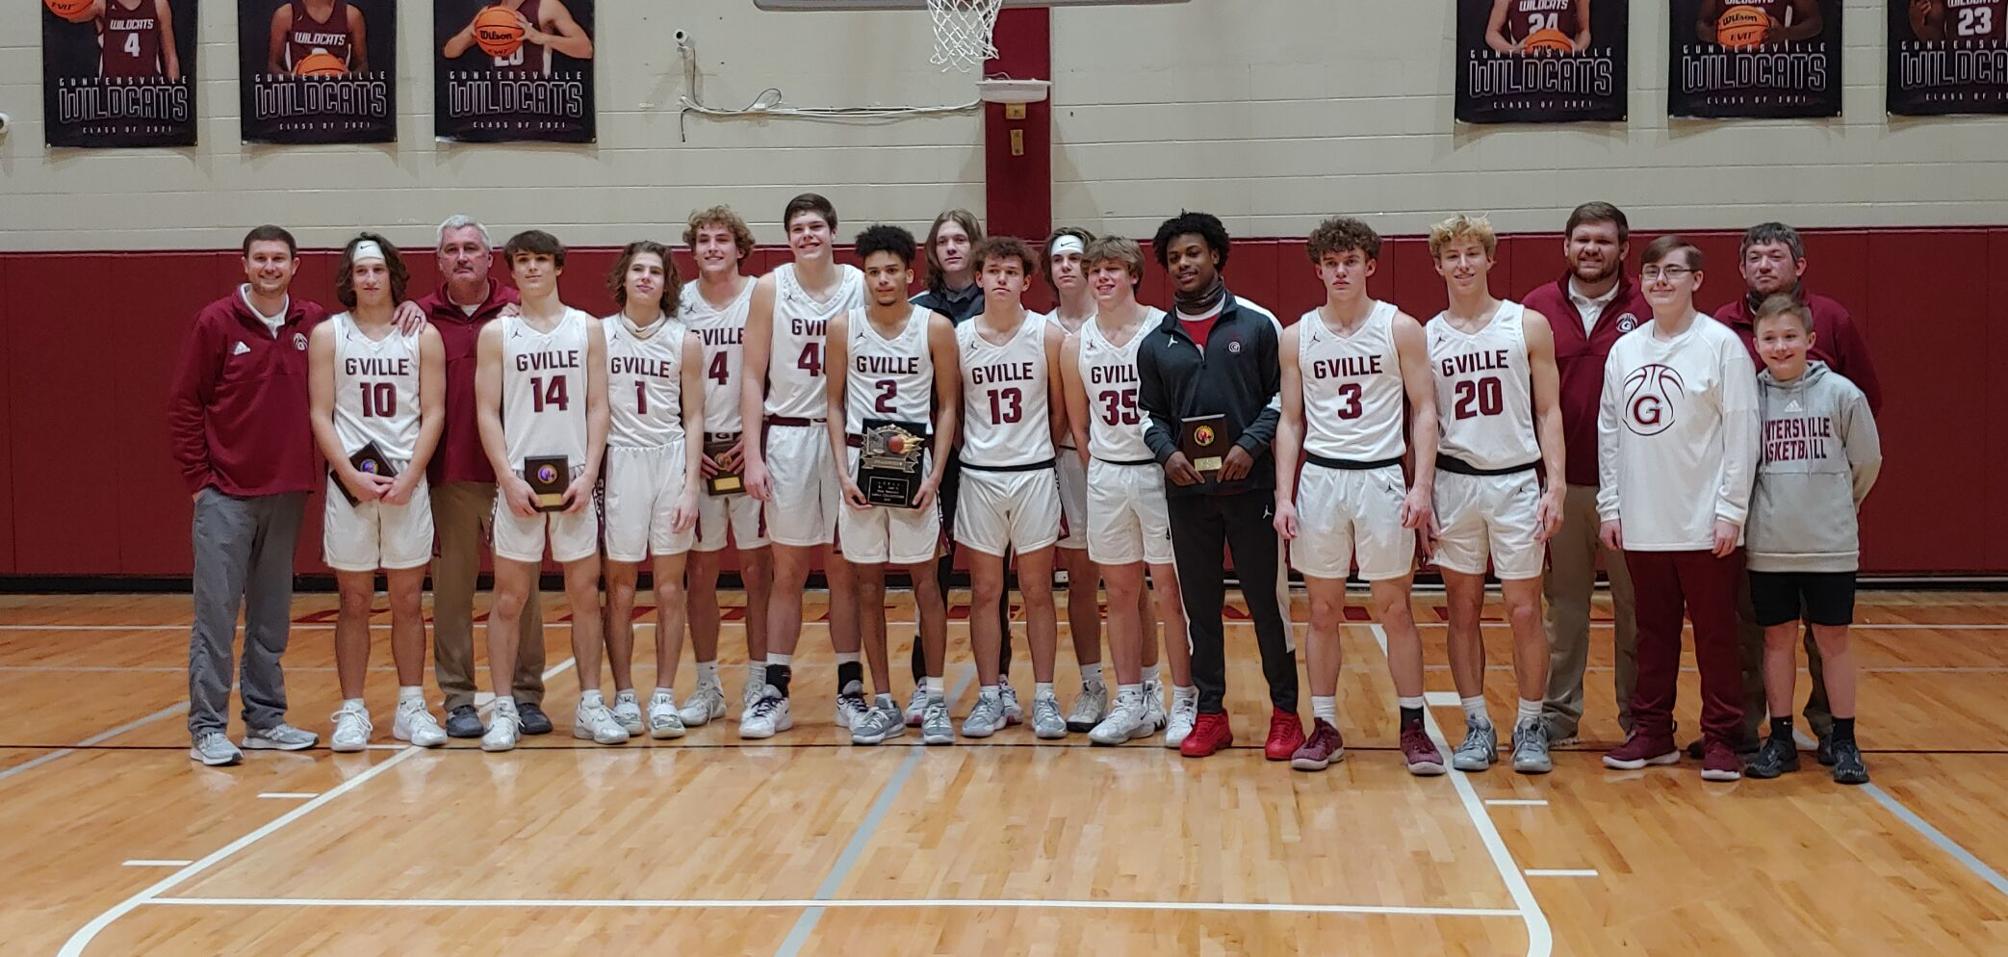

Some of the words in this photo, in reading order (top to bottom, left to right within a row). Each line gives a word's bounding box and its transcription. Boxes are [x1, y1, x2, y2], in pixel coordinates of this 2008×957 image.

[109, 19, 154, 30] WILDCATS
[1528, 13, 1559, 36] 24
[1722, 12, 1758, 26] Wilson
[1958, 7, 1992, 36] 23
[124, 33, 140, 57] 4
[295, 32, 346, 45] WILDCATS
[480, 30, 512, 40] Wilson
[1683, 43, 1826, 54] GUNTERSVILLE
[1470, 48, 1612, 59] GUNTERSVILLE
[59, 75, 187, 87] GUNTERSVILLE
[255, 71, 386, 82] GUNTERSVILLE
[449, 71, 582, 80] GUNTERSVILLE
[1470, 58, 1612, 98] WILDCATS
[1682, 53, 1826, 94] WILDCATS
[1901, 50, 2008, 90] WILDCA
[59, 86, 188, 124] WILDCATS
[255, 81, 387, 120] WILDCATS
[450, 81, 583, 118] WILDCATS
[345, 358, 410, 377] GVILLE
[516, 350, 579, 372] GVILLE
[611, 356, 671, 378] GVILLE
[708, 351, 729, 386] 4
[797, 342, 827, 377] 4
[856, 355, 919, 375] GVILLE
[972, 362, 1034, 385] GVILLE
[1313, 354, 1383, 379] GVILLE
[1441, 349, 1509, 377] GVILLE
[360, 382, 397, 418] 10
[530, 374, 569, 413] 14
[635, 380, 648, 415] 1
[875, 379, 897, 413] 2
[987, 387, 1023, 425] 13
[1099, 389, 1141, 426] 35
[1337, 382, 1363, 420] 3
[1455, 376, 1504, 421] 20
[1633, 395, 1661, 426] G
